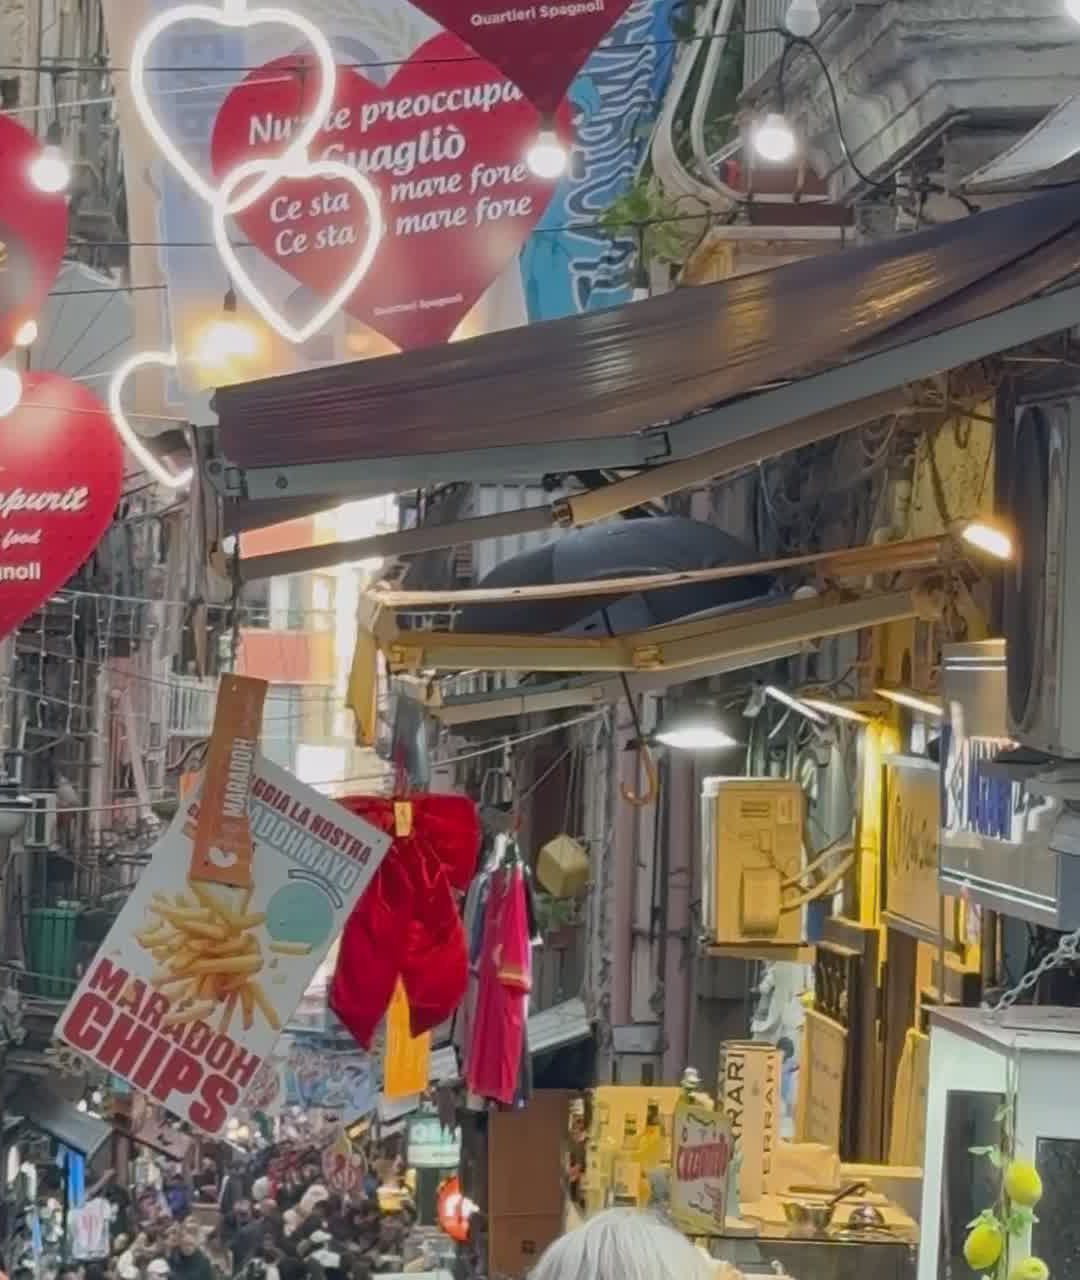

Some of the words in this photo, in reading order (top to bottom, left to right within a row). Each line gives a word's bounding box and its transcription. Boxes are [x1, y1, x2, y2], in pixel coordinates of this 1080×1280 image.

[470, 6, 536, 28] Quartieri
[270, 195, 303, 223] Ce
[309, 191, 350, 217] sta
[391, 173, 463, 203] mare
[470, 163, 529, 194] fore
[275, 228, 307, 256] Ce
[314, 223, 358, 249] sta
[395, 207, 467, 236] mare
[475, 195, 533, 227] fore
[2, 528, 41, 550] food
[62, 991, 240, 1133] CHIPS
